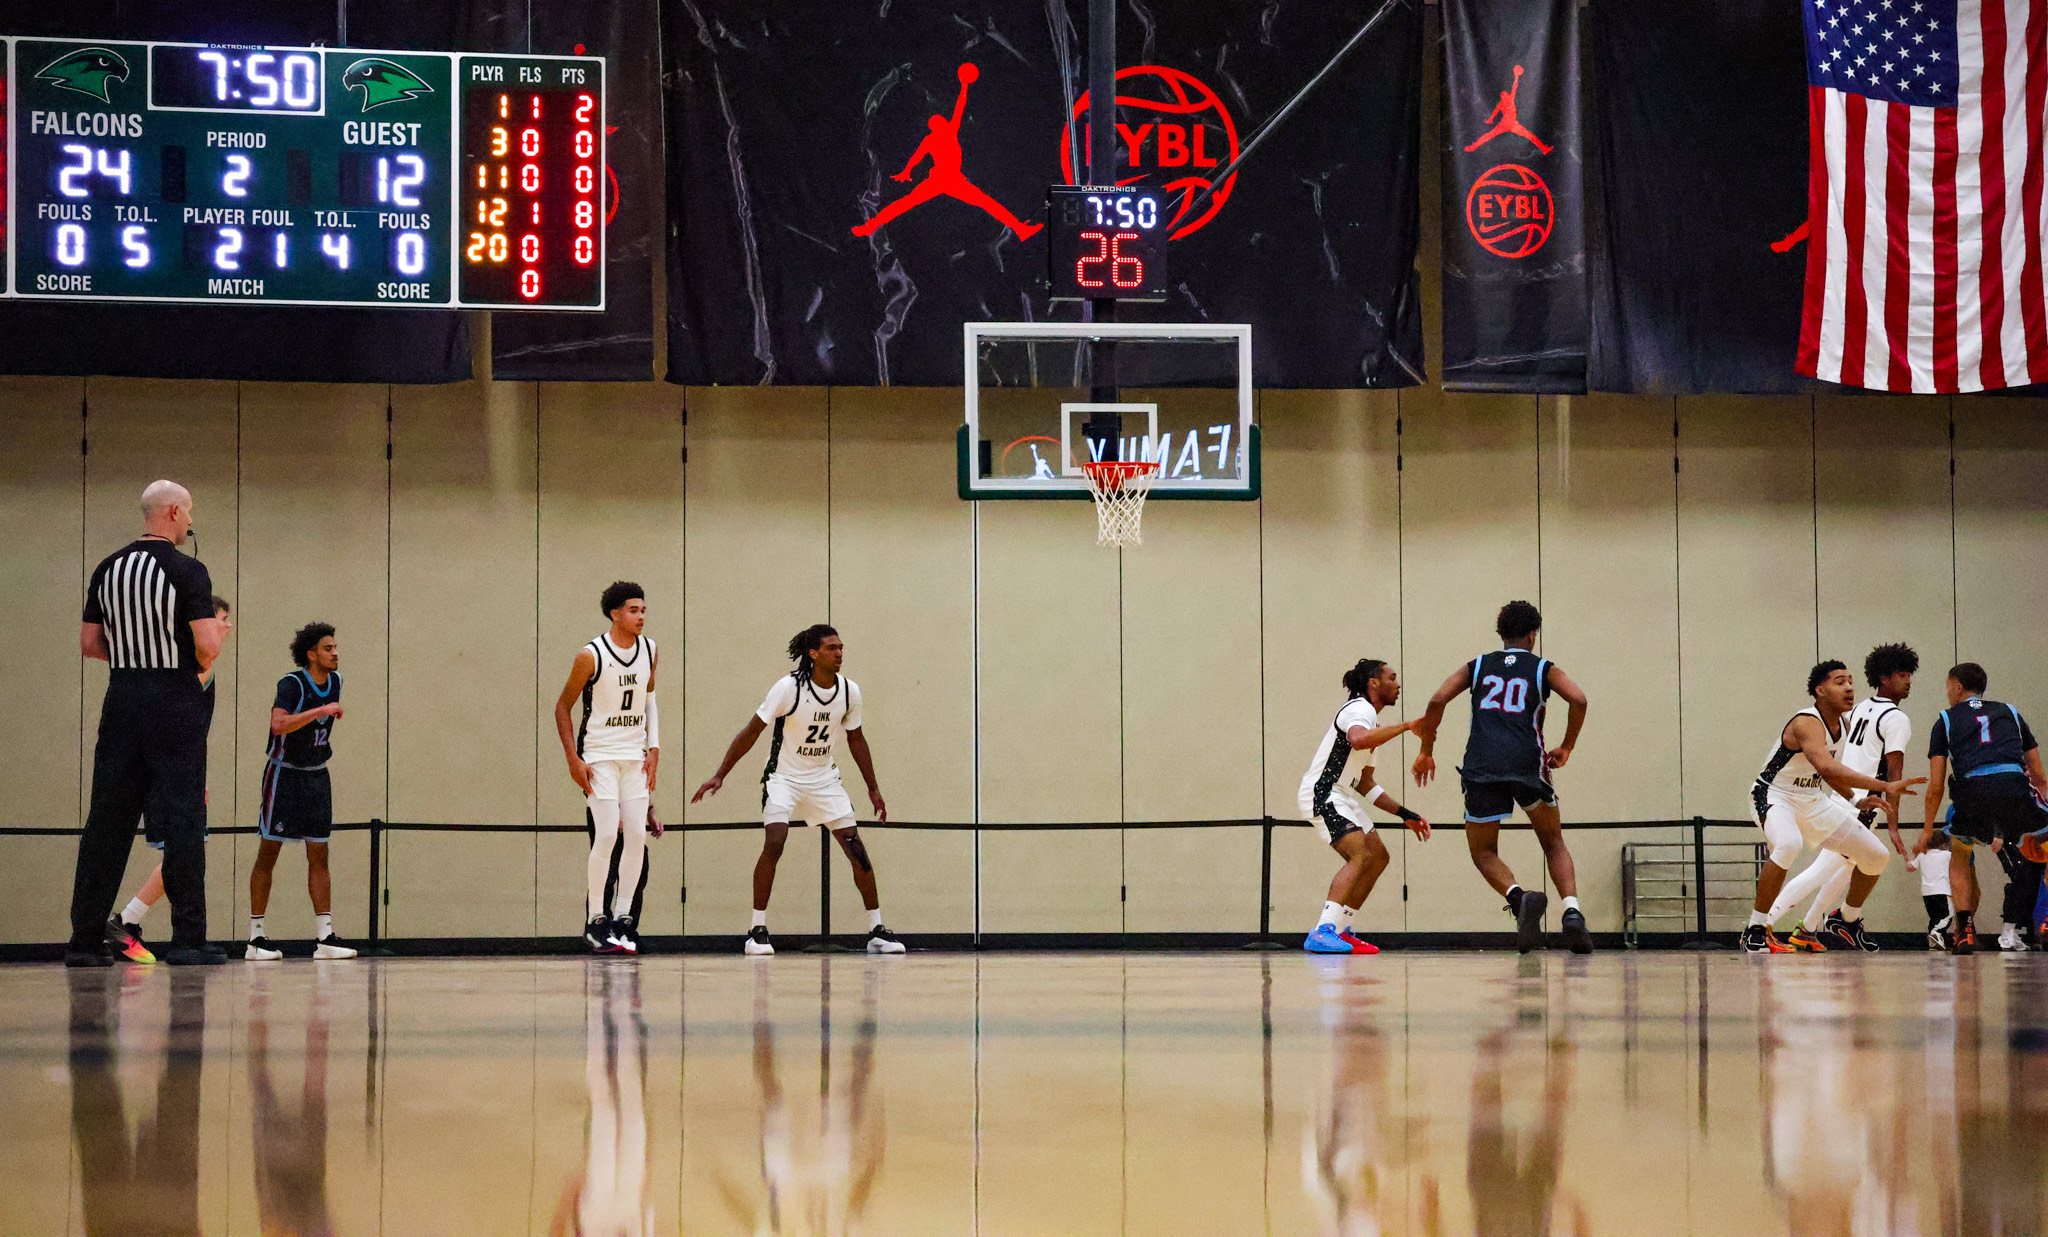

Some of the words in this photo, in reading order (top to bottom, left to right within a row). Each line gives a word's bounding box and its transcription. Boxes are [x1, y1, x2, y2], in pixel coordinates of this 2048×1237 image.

[210, 43, 262, 51] DAKTRONICS
[199, 52, 315, 107] 7:50
[472, 65, 504, 82] PLYR
[519, 66, 542, 83] FLS
[561, 68, 586, 85] PTS
[500, 95, 508, 118] 1
[533, 96, 540, 119] 1
[575, 95, 593, 123] 2
[31, 111, 143, 138] FALCONS
[343, 121, 422, 146] GUEST
[206, 131, 267, 149] PERIOD
[492, 127, 507, 156] 3
[521, 128, 540, 157] 0
[575, 130, 593, 158] 0
[1086, 123, 1218, 168] YBL
[60, 144, 130, 197] 24
[223, 155, 250, 197] 2
[378, 155, 424, 206] 12
[479, 165, 508, 189] 11
[521, 164, 540, 192] 0
[575, 165, 593, 193] 0
[1081, 185, 1137, 193] DAKTRONICS
[38, 203, 92, 221] FOULS
[114, 205, 158, 223] T.O.L.
[183, 207, 245, 225] PLAYER
[252, 209, 294, 226] FOUL
[314, 211, 357, 228] T.O.L.
[479, 198, 508, 226] 12
[532, 202, 540, 225] 1
[575, 200, 593, 229] 8
[1087, 196, 1157, 229] 7:50
[1478, 194, 1544, 219] EYBL
[378, 212, 431, 230] FOULS
[57, 223, 85, 266] 0
[122, 225, 150, 268] 5
[215, 228, 242, 270] 2
[276, 232, 286, 268] 1
[322, 234, 349, 270] 4
[398, 233, 424, 274] 0
[467, 232, 507, 262] 20
[521, 234, 540, 262] 0
[574, 235, 593, 264] 0
[1076, 232, 1143, 287] 26
[36, 274, 92, 291] SCORE
[208, 278, 264, 295] MATCH
[377, 282, 430, 300] SCORE
[521, 269, 539, 298] 0
[618, 673, 638, 687] LINK
[1479, 674, 1528, 713] 20
[621, 689, 633, 710] 0
[813, 711, 831, 722] LINK
[1975, 714, 1992, 743] 1
[314, 728, 327, 746] 12
[805, 724, 829, 743] 24
[1849, 717, 1869, 746] 10
[796, 745, 831, 756] ACADEMY
